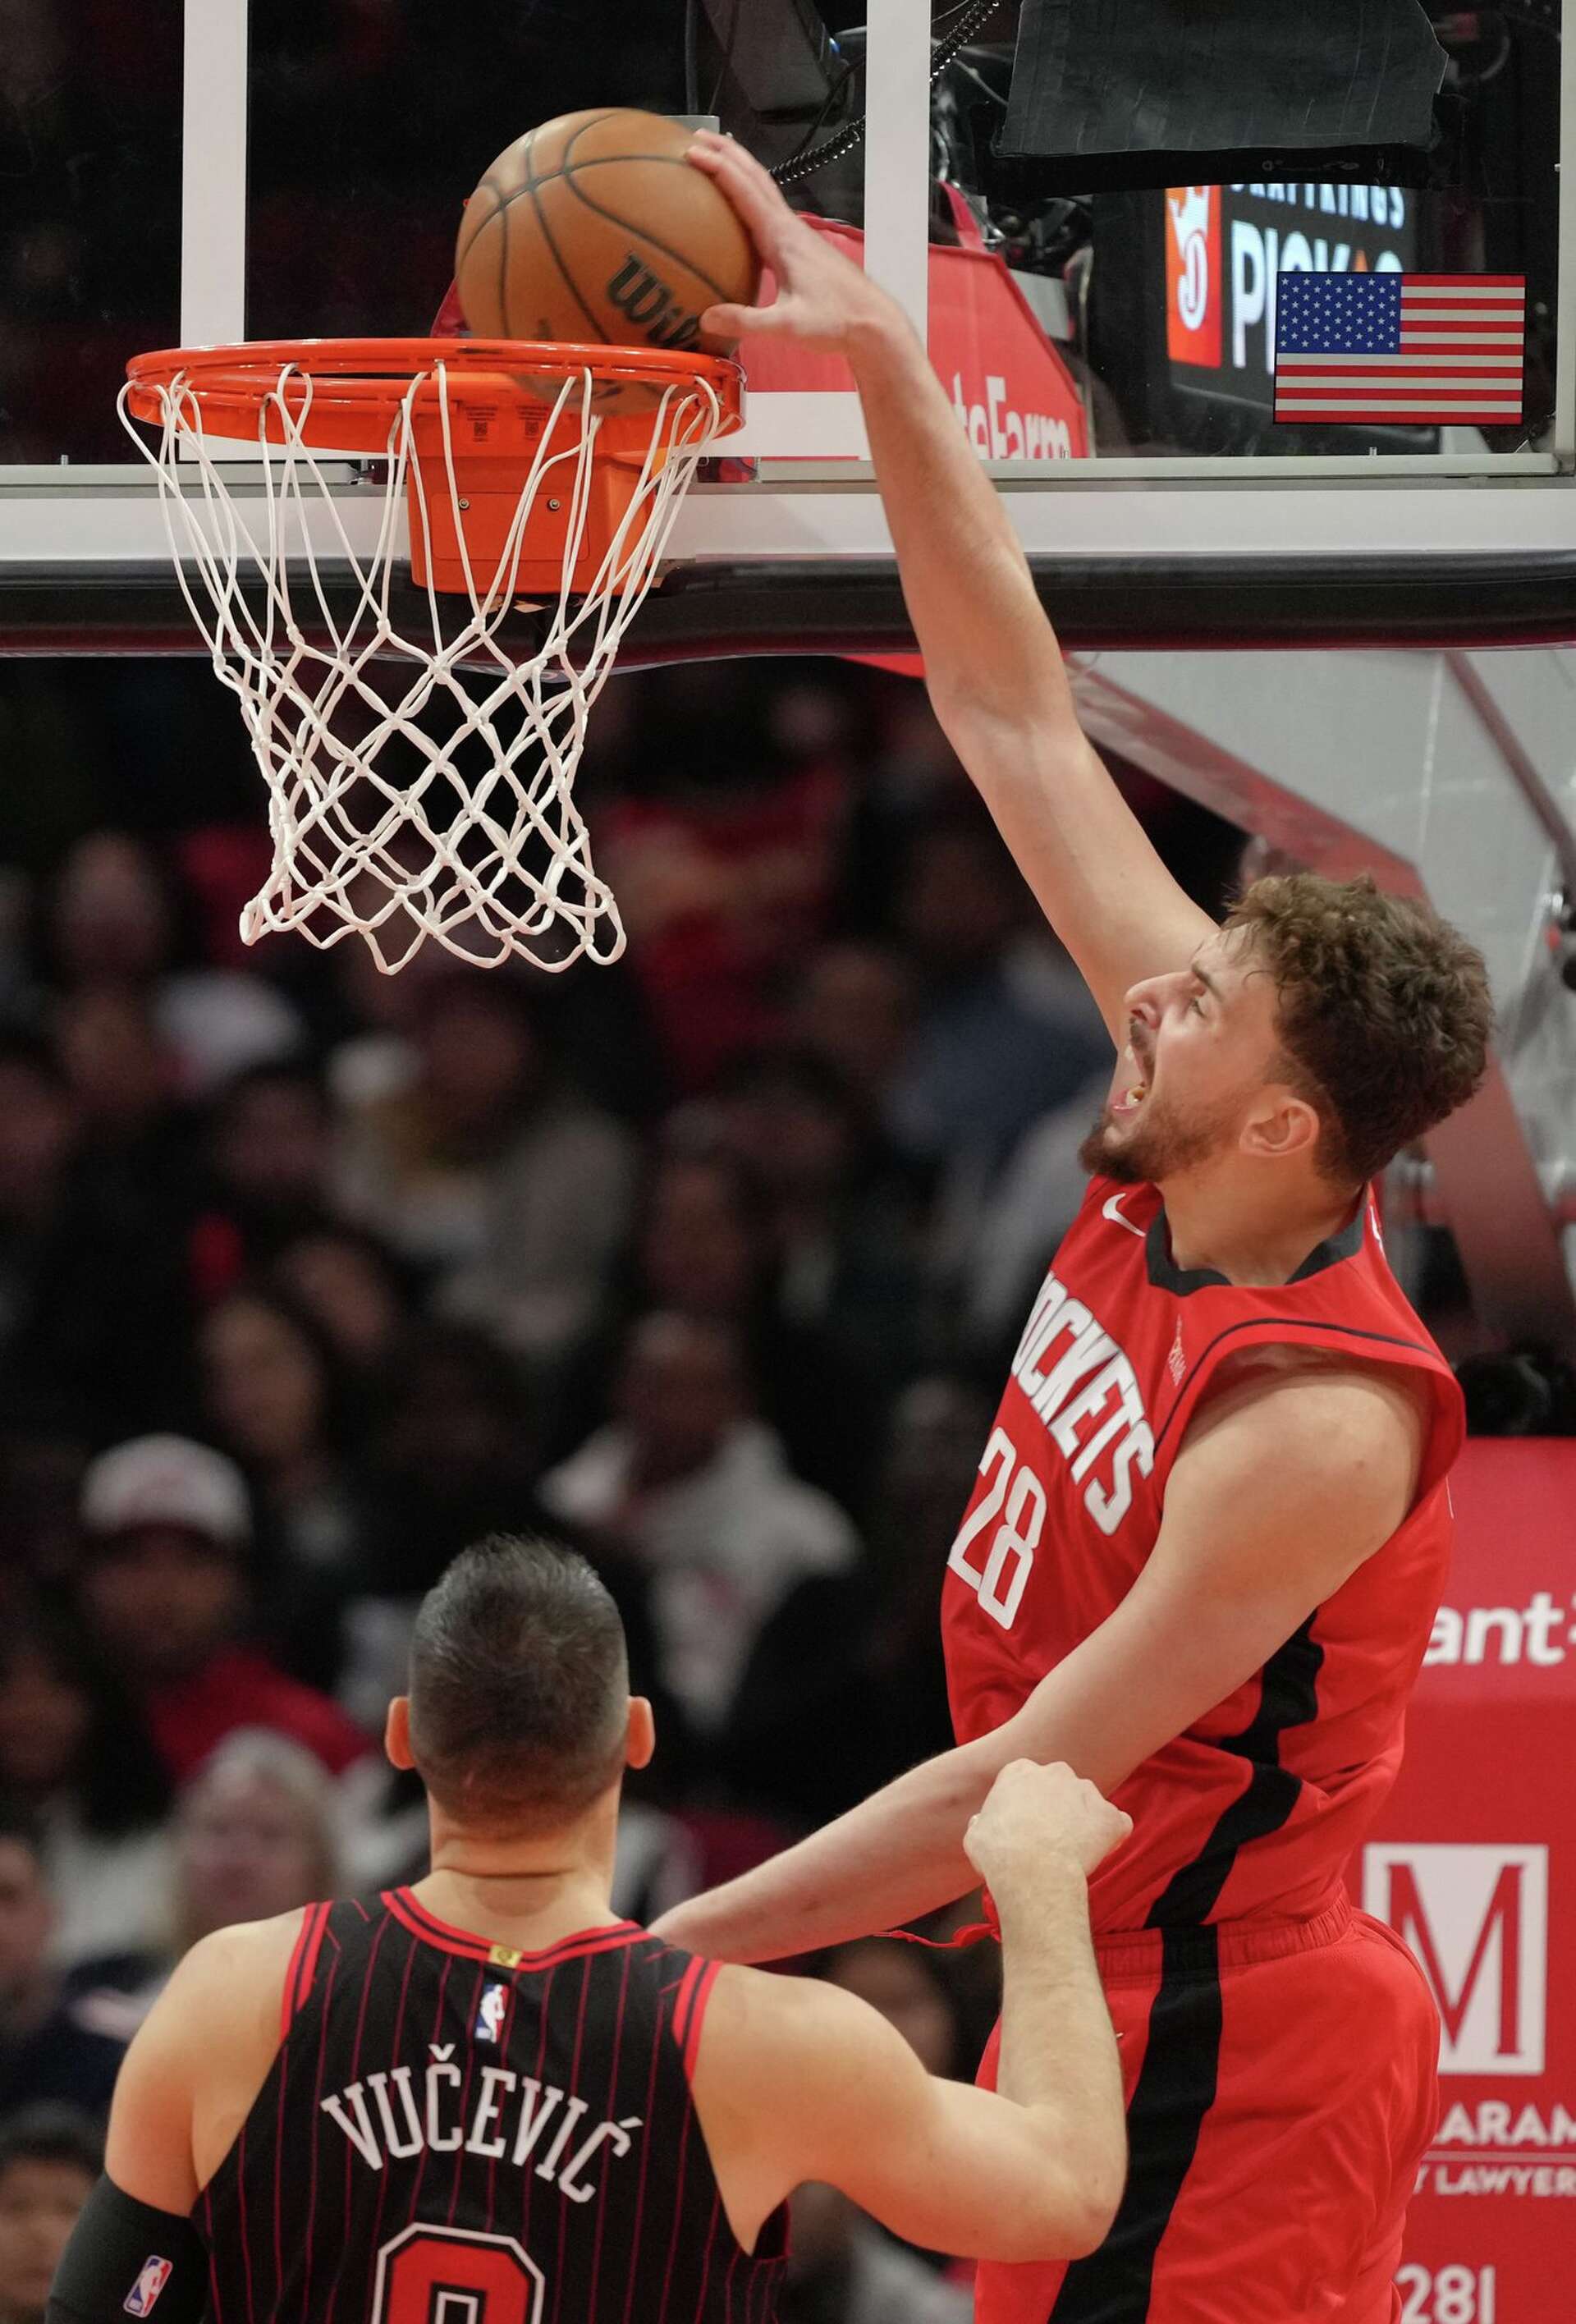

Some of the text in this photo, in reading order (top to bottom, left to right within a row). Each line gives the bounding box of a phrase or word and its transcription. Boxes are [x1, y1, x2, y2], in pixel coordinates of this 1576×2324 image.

[1011, 1271, 1154, 1536] OCKETS
[947, 1427, 1047, 1630] 28
[320, 2043, 644, 2203] VUČEVIĆ
